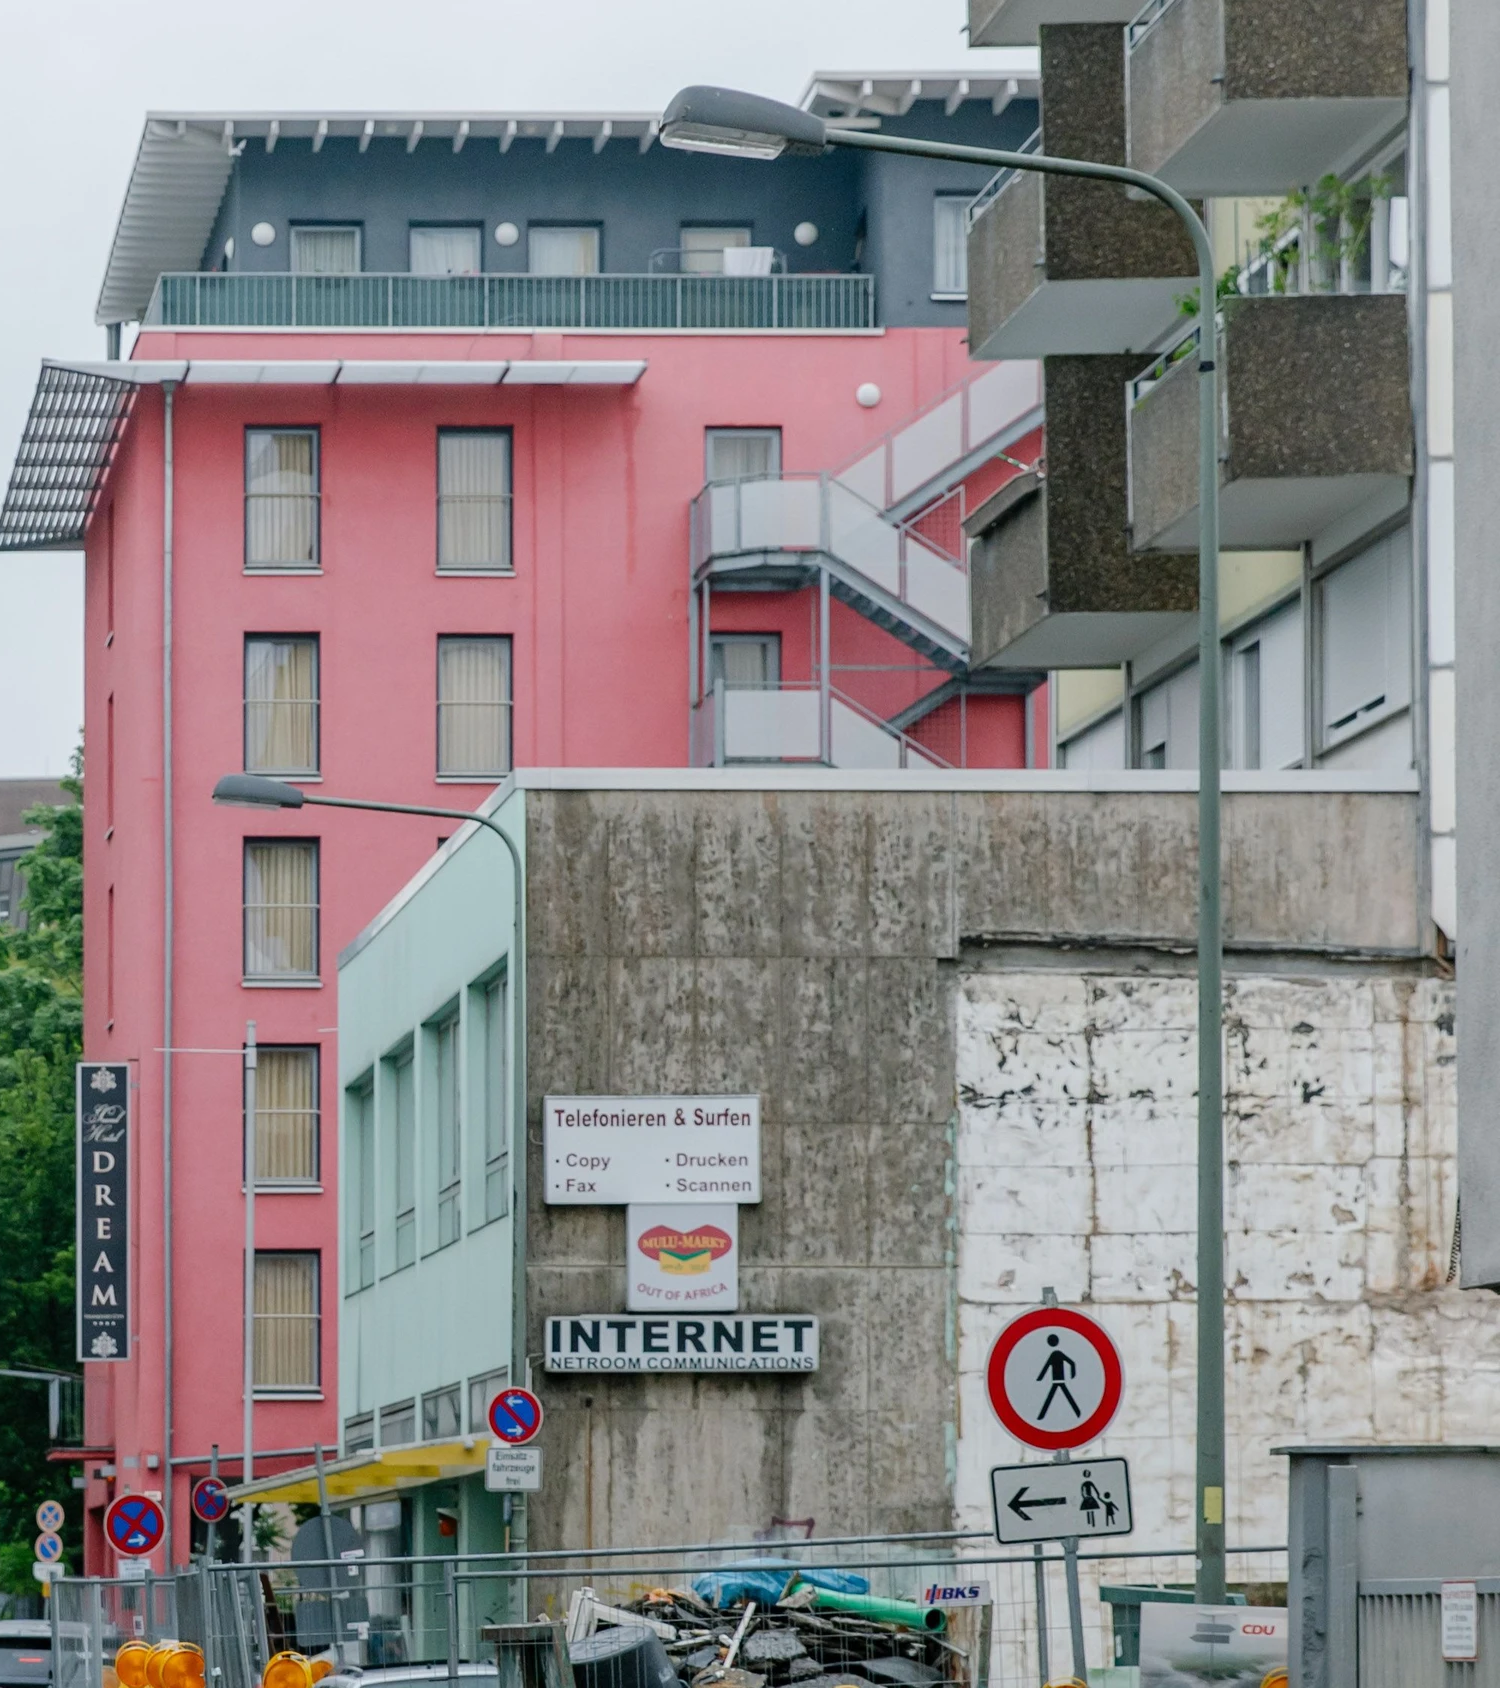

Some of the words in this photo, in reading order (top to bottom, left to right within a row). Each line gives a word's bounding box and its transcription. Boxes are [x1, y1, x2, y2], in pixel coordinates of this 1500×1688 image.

[554, 1108, 666, 1128] Telefonieren
[673, 1108, 686, 1128] &
[693, 1108, 751, 1128] Surfen
[565, 1153, 611, 1171] Copy
[676, 1152, 748, 1167] Drucken
[565, 1179, 596, 1193] Fax
[676, 1178, 752, 1192] Scannen
[91, 1151, 117, 1306] DREAM
[642, 1235, 727, 1249] MULU-MARKT
[637, 1283, 663, 1298] OUT
[665, 1290, 682, 1301] OF
[684, 1282, 728, 1301] AFRICA
[551, 1320, 814, 1353] INTERNET
[551, 1356, 641, 1370] NETROOM
[647, 1356, 814, 1370] COMMUNICATIONS
[492, 1462, 536, 1475] fahrzeuge
[505, 1476, 521, 1486] frei
[941, 1585, 980, 1600] BKS
[1241, 1623, 1276, 1636] CDU
